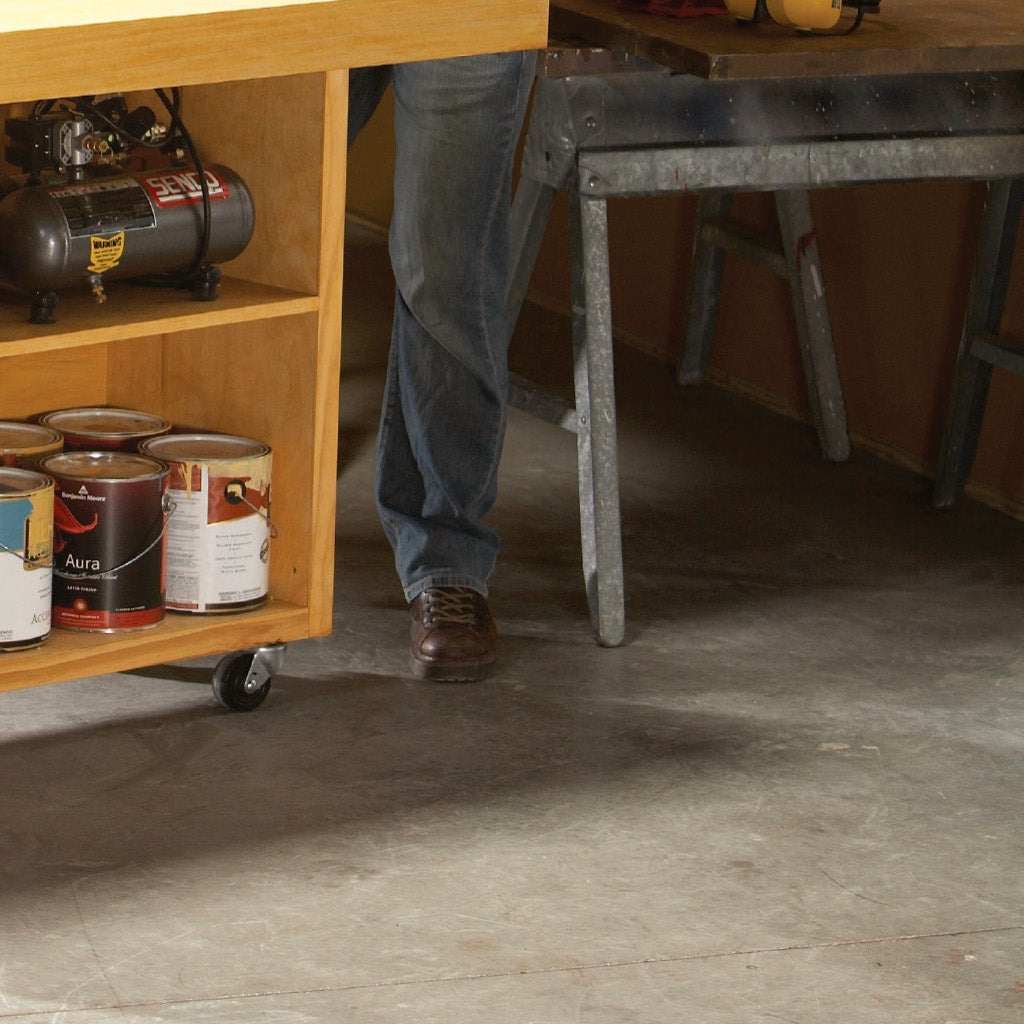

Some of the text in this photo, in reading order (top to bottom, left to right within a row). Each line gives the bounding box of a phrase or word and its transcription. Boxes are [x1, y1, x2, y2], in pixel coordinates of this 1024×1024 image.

[146, 170, 220, 196] SENCO
[92, 236, 122, 250] WARNING
[61, 491, 106, 502] Benjamin Moore
[65, 553, 100, 570] Aura
